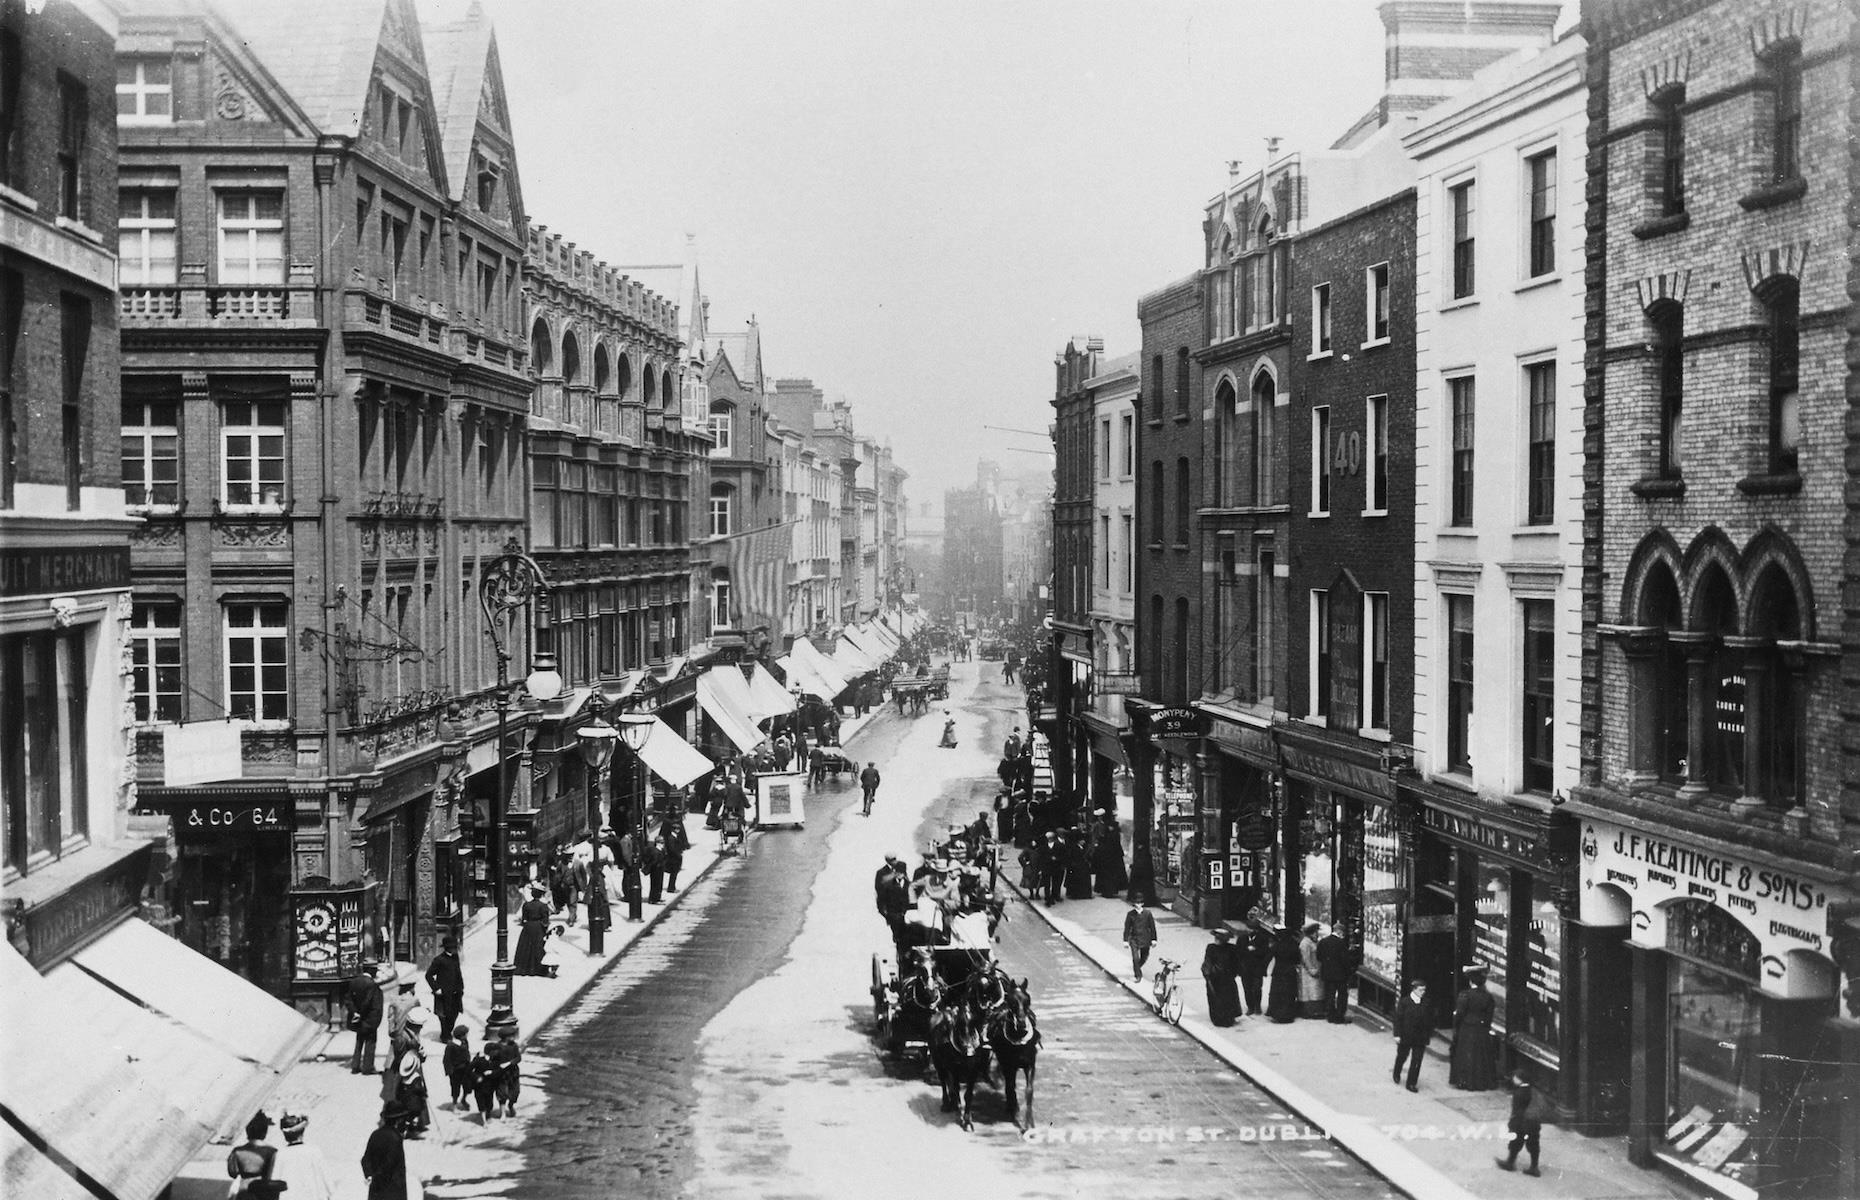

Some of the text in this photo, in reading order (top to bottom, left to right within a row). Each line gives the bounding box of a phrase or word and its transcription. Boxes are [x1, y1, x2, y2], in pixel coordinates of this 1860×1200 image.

[1334, 431, 1361, 476] 40
[1150, 708, 1197, 723] MONYPENY
[1166, 721, 1181, 729] 39
[1165, 792, 1193, 800] TELEPHONE
[188, 808, 203, 826] &
[252, 807, 278, 825] 64
[1645, 838, 1733, 889] KEATINGE
[1737, 866, 1753, 892] &
